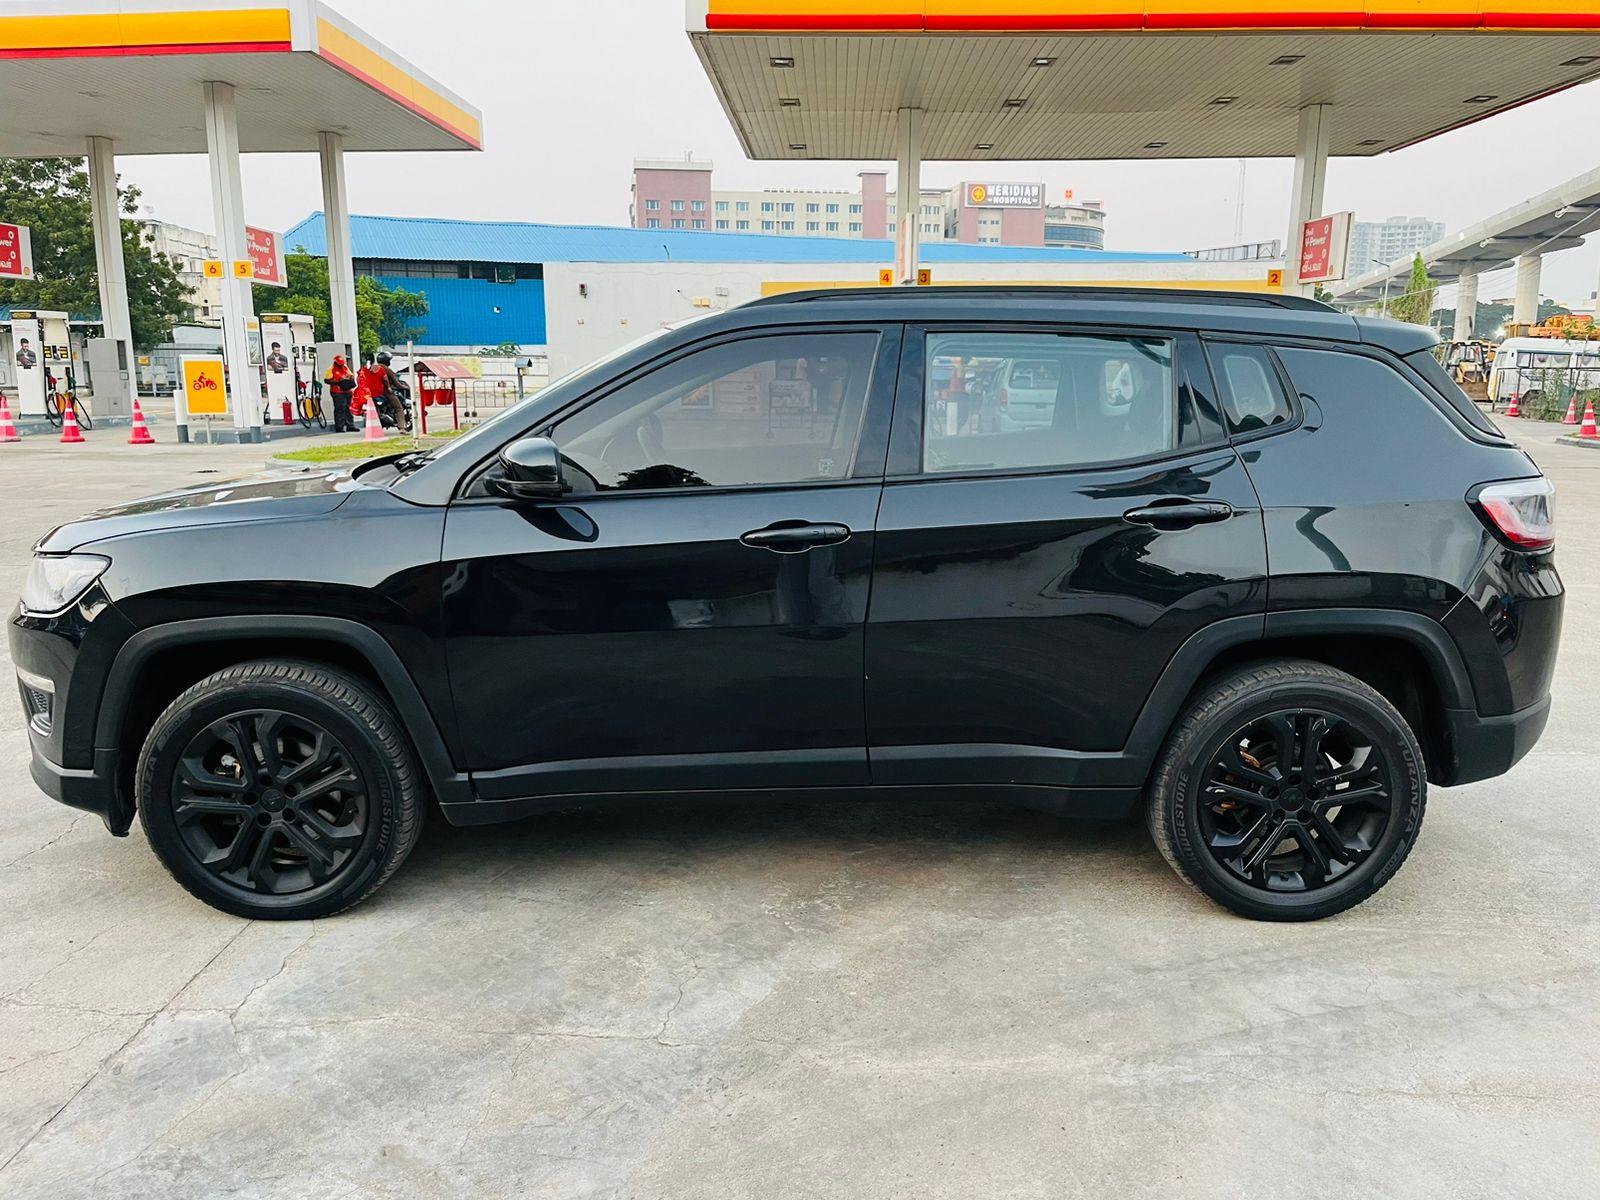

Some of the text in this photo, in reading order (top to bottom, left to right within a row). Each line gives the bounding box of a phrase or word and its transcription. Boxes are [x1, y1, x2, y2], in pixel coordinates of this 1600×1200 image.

[987, 185, 1039, 197] MERIDIAN
[209, 264, 217, 274] 6
[239, 264, 247, 274] 5
[882, 273, 890, 283] 4
[920, 272, 928, 283] 3
[1271, 273, 1279, 284] 2
[1396, 736, 1420, 833] TURANZA
[367, 752, 393, 852] IDGESTONE
[1174, 768, 1204, 873] RIDGESTONE
